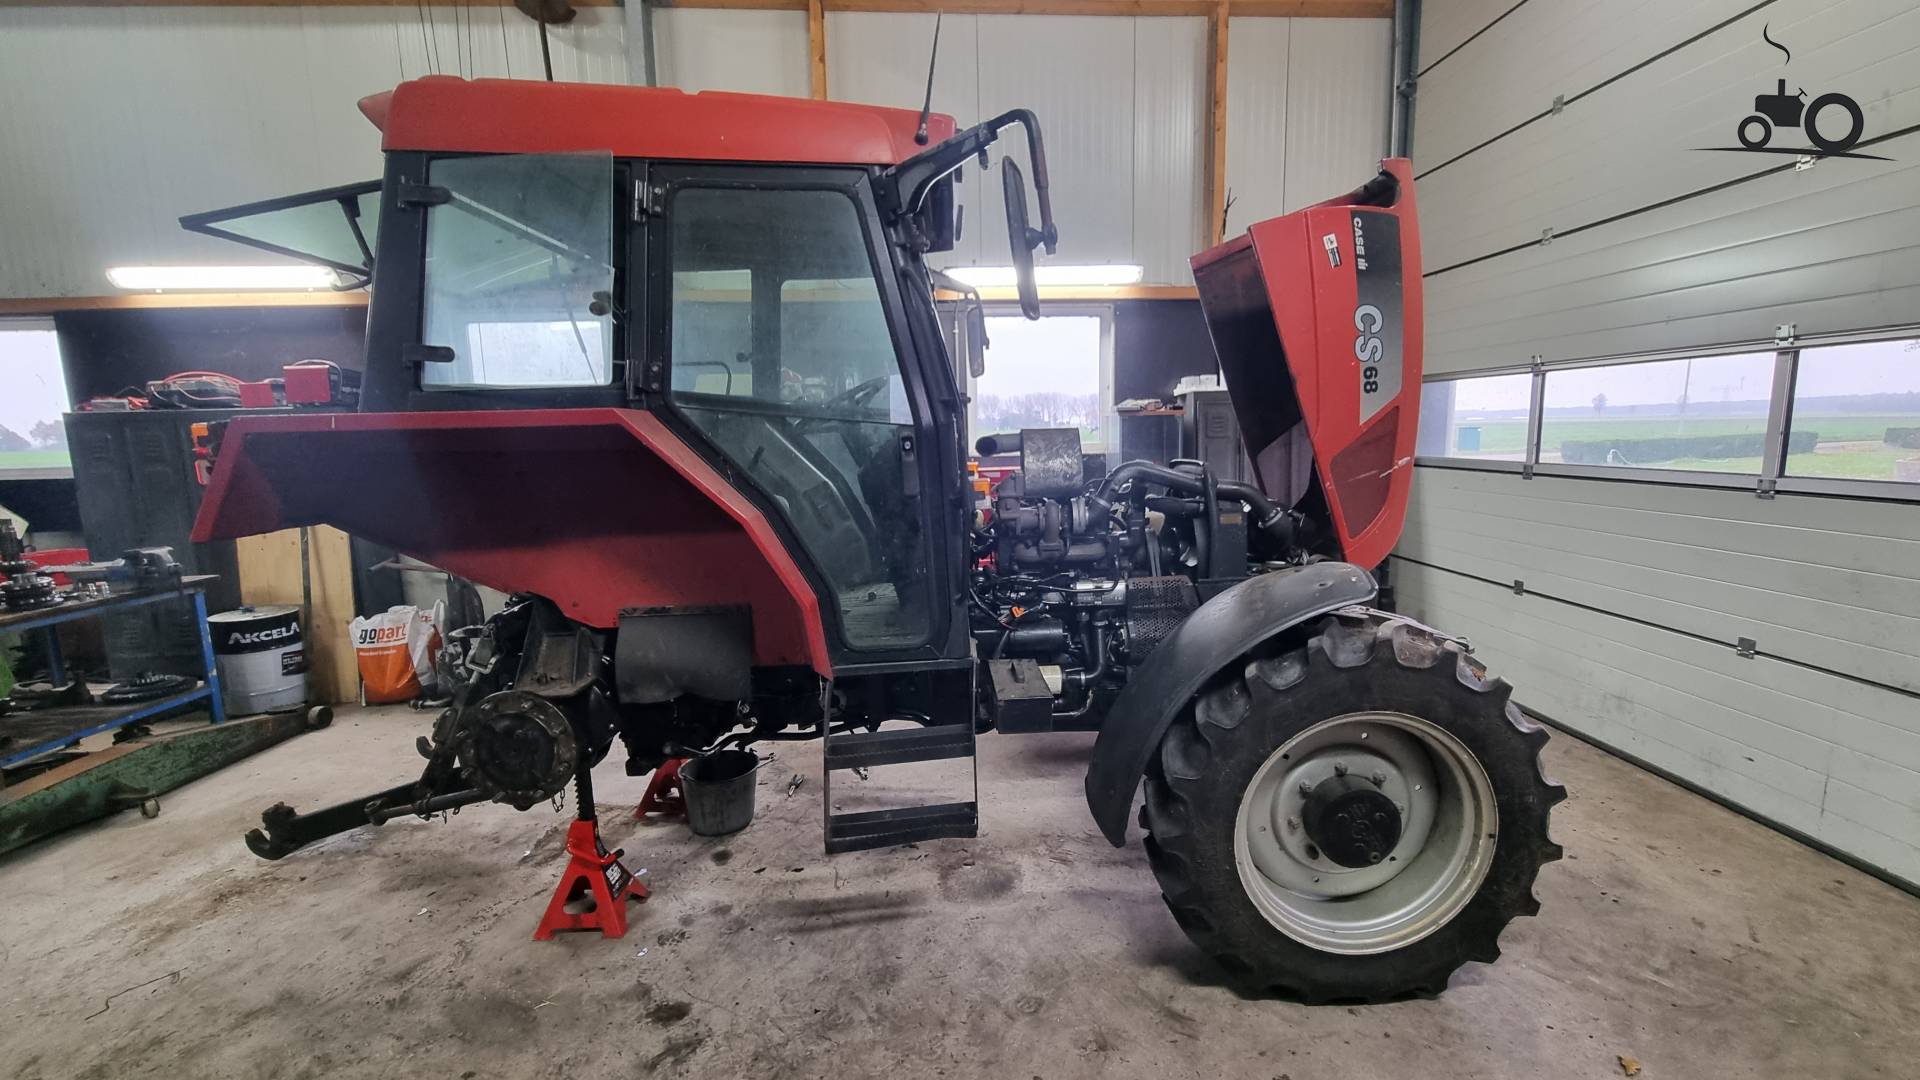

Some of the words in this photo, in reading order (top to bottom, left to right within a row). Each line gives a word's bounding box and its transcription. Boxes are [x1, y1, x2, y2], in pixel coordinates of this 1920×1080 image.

[1354, 217, 1365, 255] CASE
[1354, 304, 1384, 363] CS
[1363, 366, 1378, 394] 68
[228, 622, 300, 644] AKCELA
